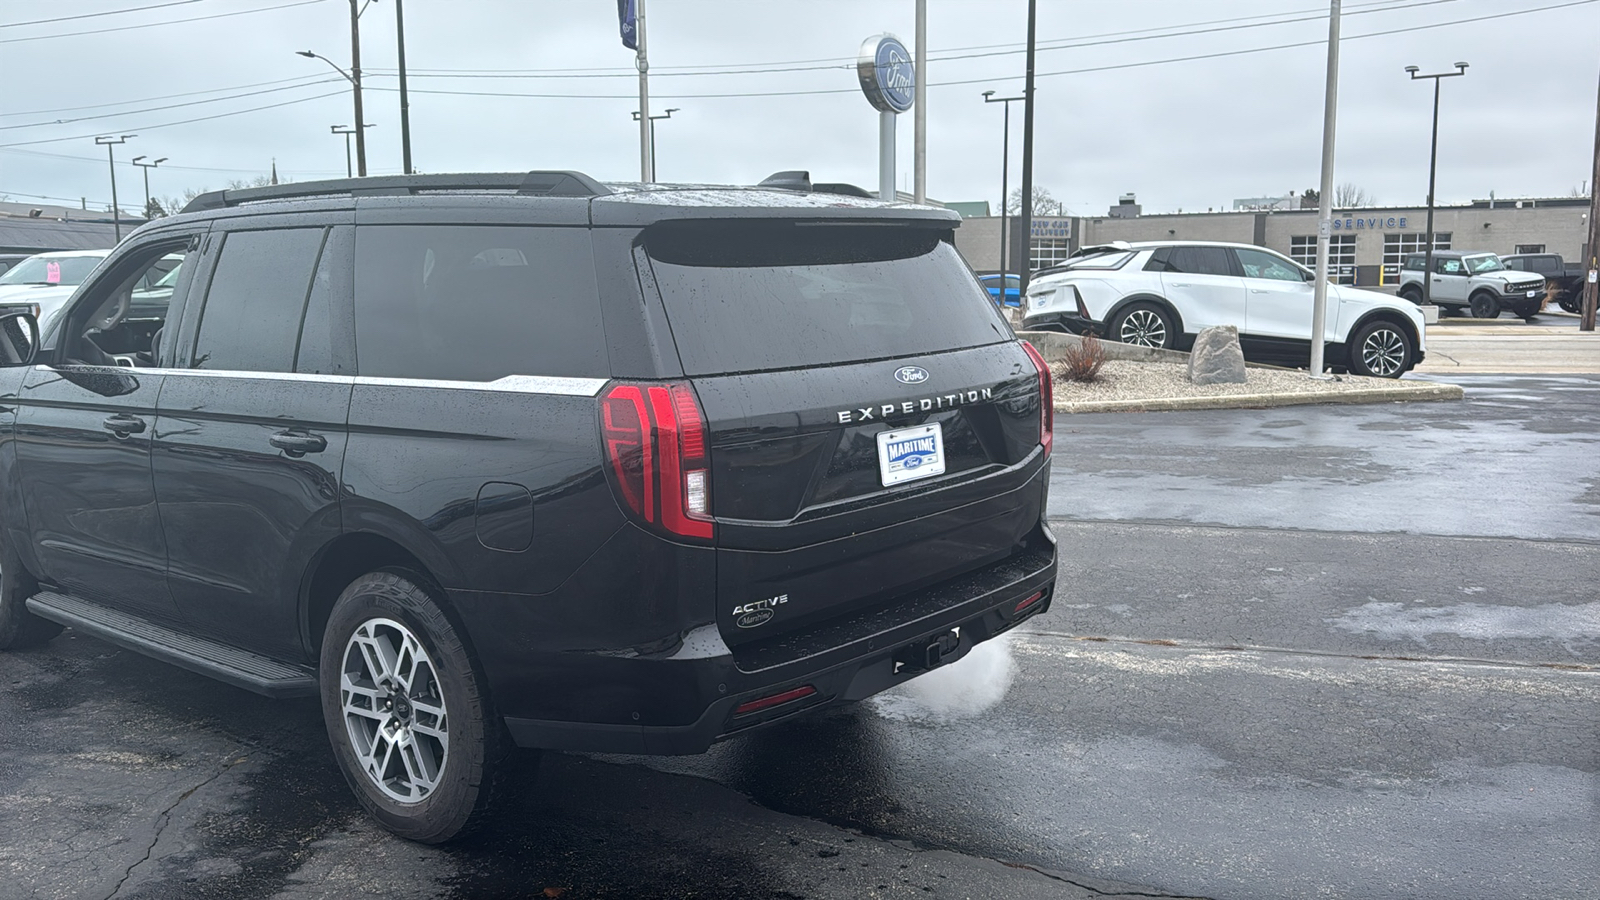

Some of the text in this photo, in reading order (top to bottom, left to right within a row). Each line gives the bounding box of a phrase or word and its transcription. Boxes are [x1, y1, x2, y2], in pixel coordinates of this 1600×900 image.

[887, 50, 911, 98] Ford
[1334, 218, 1406, 228] SERVICE
[902, 369, 923, 382] Ford
[837, 388, 991, 423] EXPEDITION
[888, 437, 935, 461] MARITIME
[906, 457, 920, 467] Ford
[733, 594, 788, 615] ACTIVE
